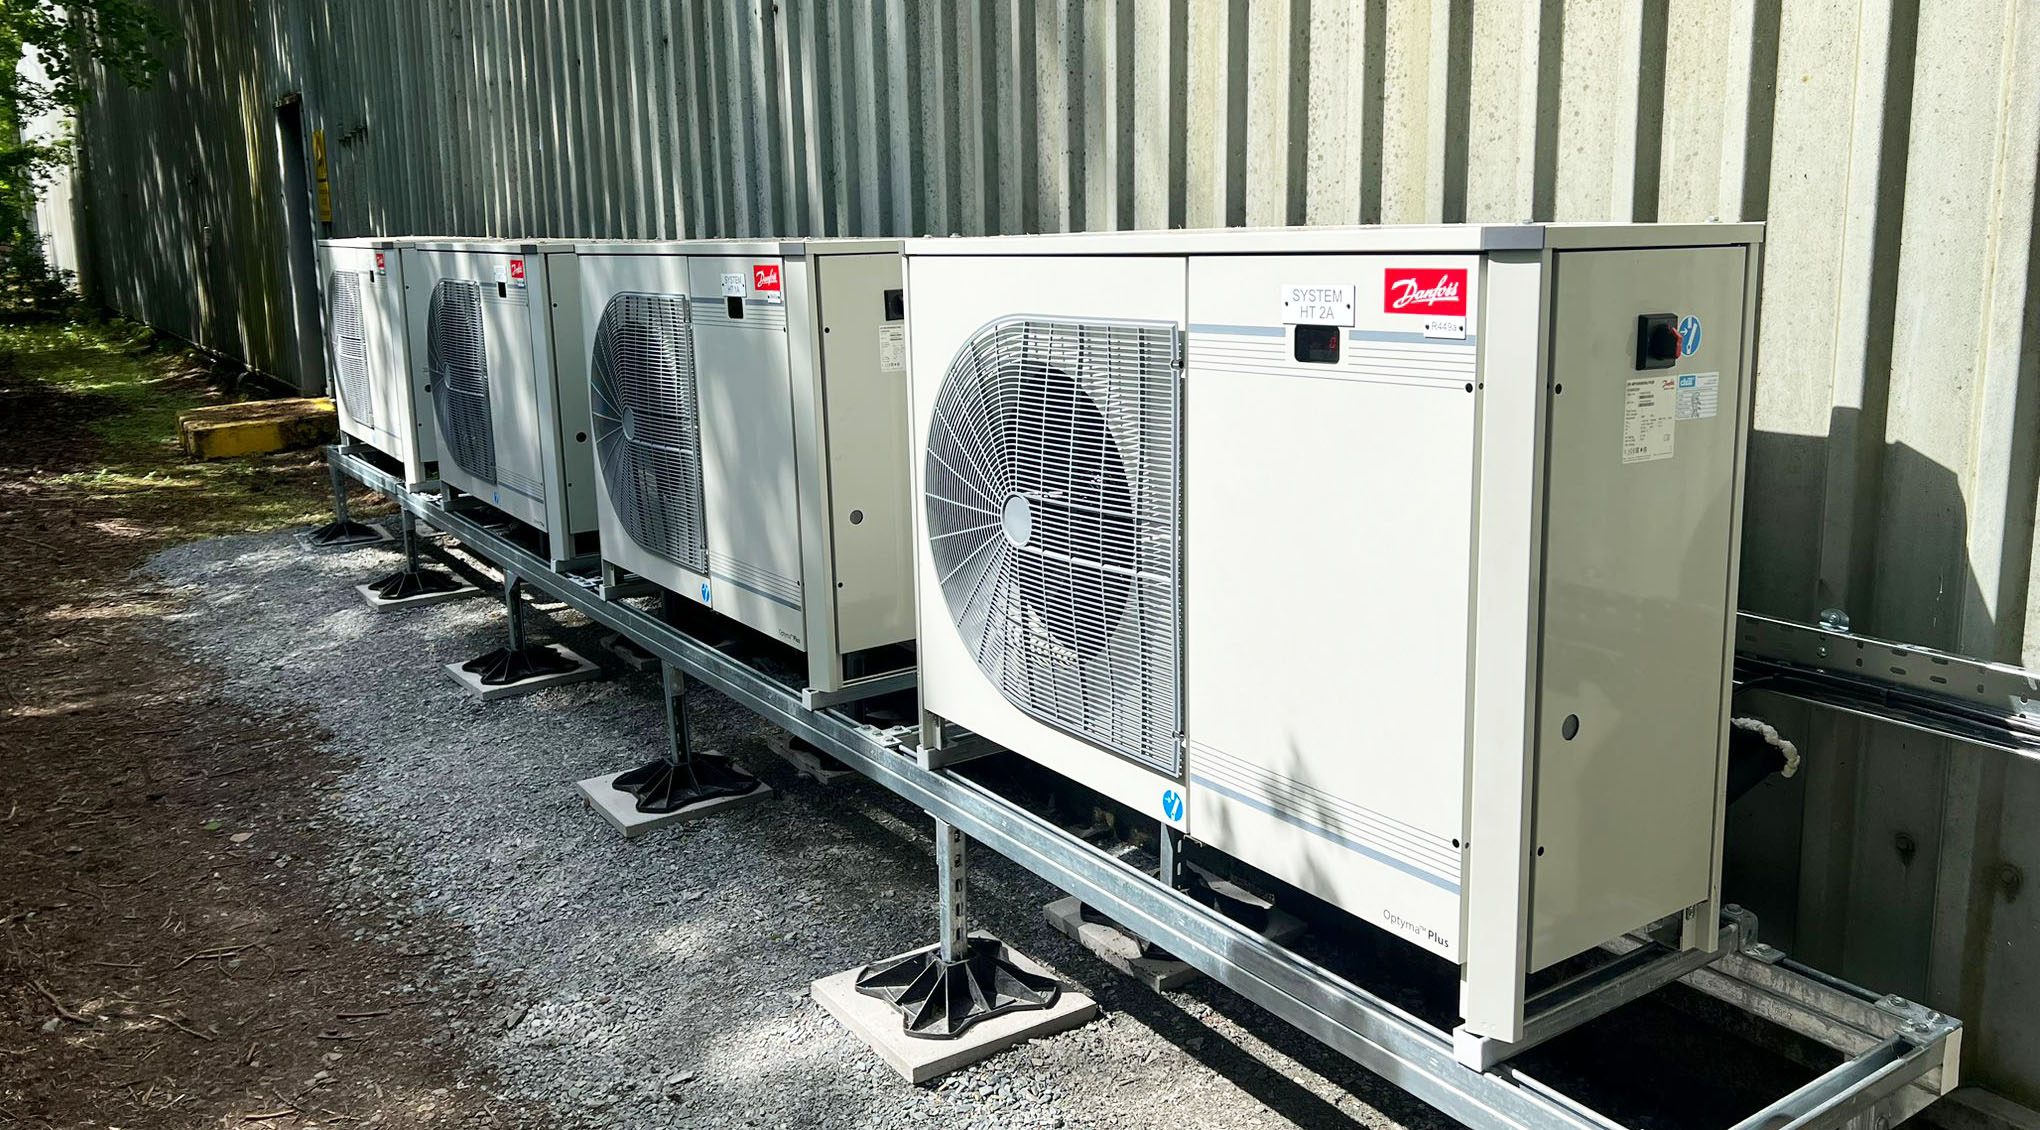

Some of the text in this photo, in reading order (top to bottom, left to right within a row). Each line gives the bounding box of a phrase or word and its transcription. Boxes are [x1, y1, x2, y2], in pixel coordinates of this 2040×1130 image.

[1292, 288, 1343, 303] SYSTEM
[1391, 274, 1460, 309] Danfoss
[1300, 306, 1335, 320] HT 2A
[1431, 321, 1457, 332] R449a
[1428, 929, 1449, 948] Plus
